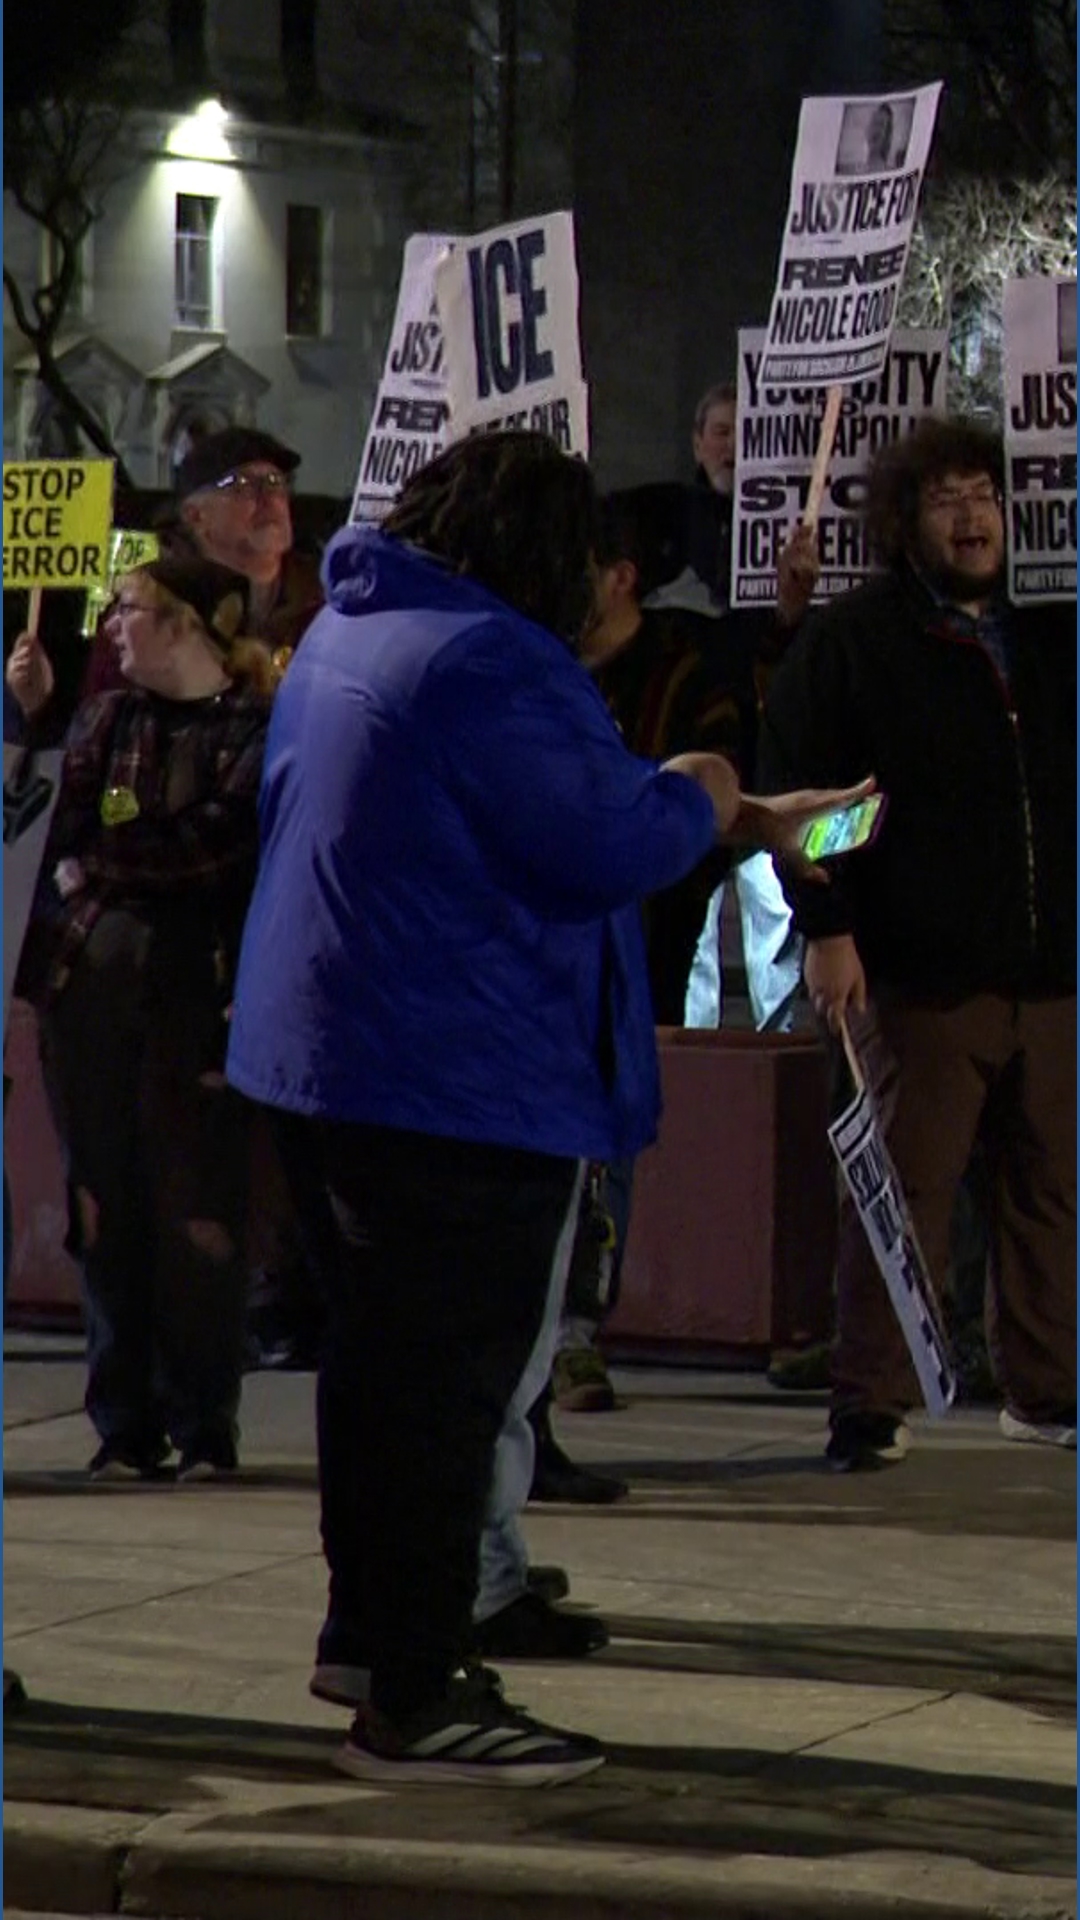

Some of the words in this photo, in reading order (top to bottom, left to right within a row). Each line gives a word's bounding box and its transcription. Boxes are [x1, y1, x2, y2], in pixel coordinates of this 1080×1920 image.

[791, 178, 890, 234] JUSTICE
[782, 243, 906, 290] RENEE
[467, 229, 554, 400] ICE
[771, 293, 853, 344] NICOLE
[4, 468, 85, 501] STOP
[8, 506, 63, 540] ICE
